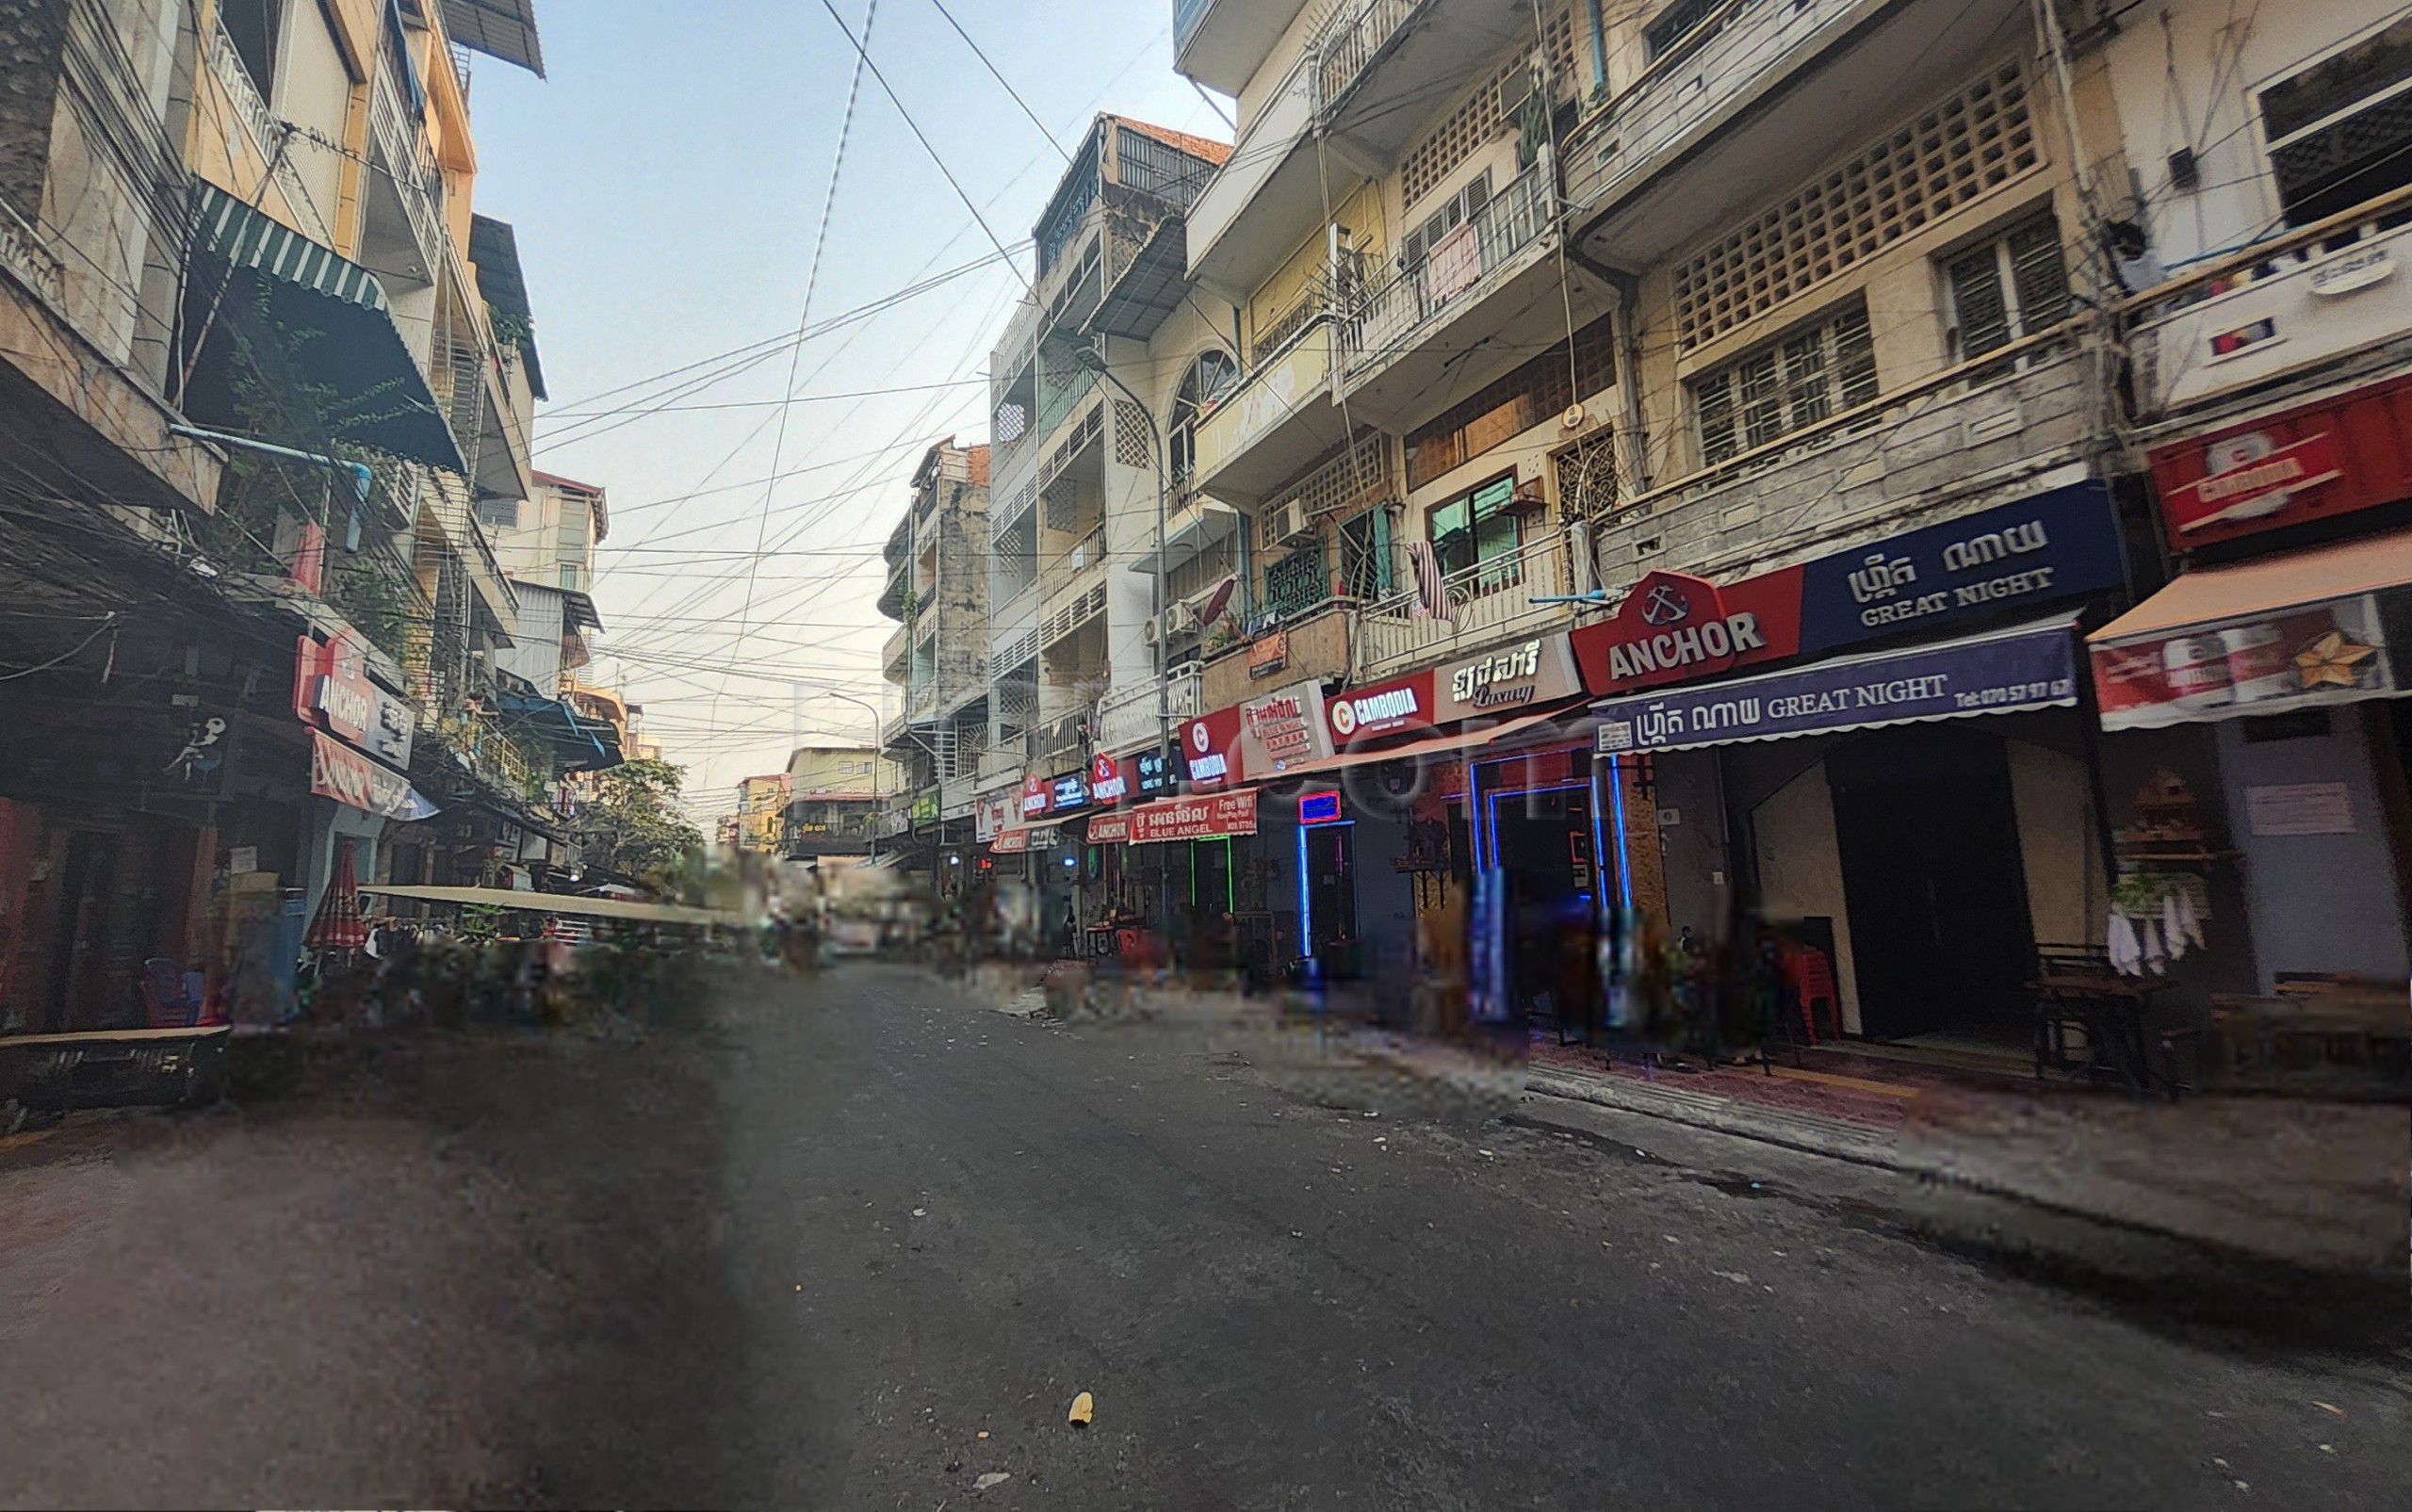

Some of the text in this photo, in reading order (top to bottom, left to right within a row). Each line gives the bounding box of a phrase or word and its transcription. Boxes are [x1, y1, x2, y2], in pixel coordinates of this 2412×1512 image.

[1861, 566, 2054, 627] GREAT NIGHT
[1609, 611, 1768, 680] ANCHOR
[318, 675, 368, 732] ANCHOR
[1353, 687, 1418, 725] CAMBODIA
[1475, 684, 1536, 707] Luxury
[1768, 689, 1850, 719] GREAT
[1853, 674, 1948, 707] NIGHT
[1093, 776, 1127, 800] ANCHOR
[1218, 795, 1254, 811] Free Wifi
[1150, 826, 1175, 838] BLUE
[1177, 822, 1214, 836] ANGEL
